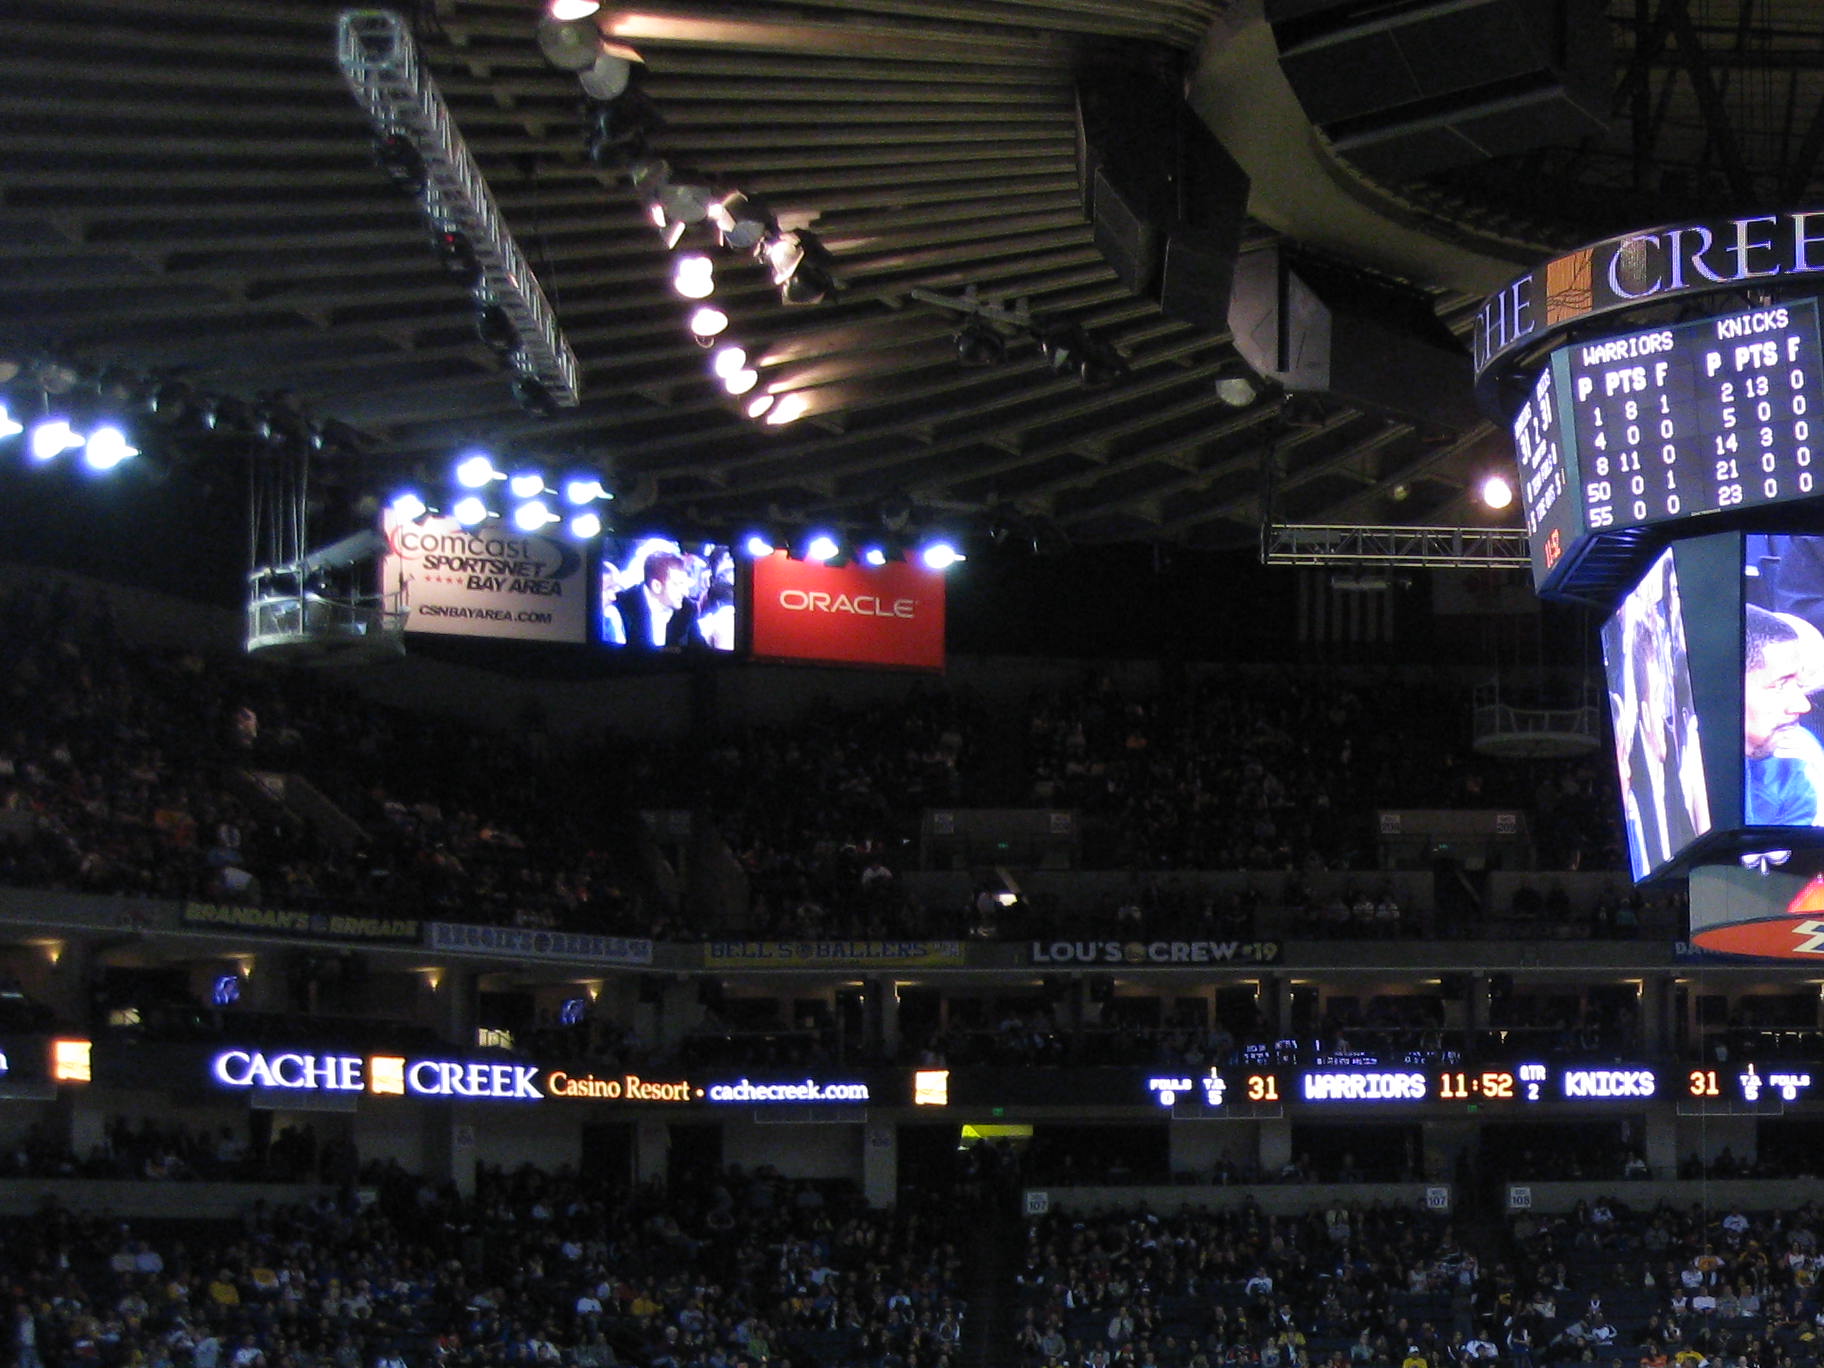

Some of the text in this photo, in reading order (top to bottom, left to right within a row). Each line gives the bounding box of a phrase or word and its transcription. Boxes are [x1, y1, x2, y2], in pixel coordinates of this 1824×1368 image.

[1583, 309, 1789, 367] WARRIORS KNICKS
[1578, 336, 1800, 401] P PTS F P PTS F
[1593, 369, 1804, 426] 1 8 1 2 13 0
[1594, 395, 1806, 450] 4 0 0 5 0 0
[1596, 421, 1808, 476] 8 11 0 14 3 0
[1587, 447, 1810, 502] 50 0 1 21 0 0
[1589, 506, 1613, 527] 55
[1633, 501, 1646, 520] 0
[1667, 495, 1680, 514] 0
[1718, 485, 1742, 506] 23
[1764, 479, 1777, 498] 0
[1799, 472, 1812, 491] 0
[400, 530, 531, 560] comcast
[422, 554, 546, 578] SPORTSNET
[466, 574, 562, 597] BAY AREA
[418, 604, 552, 625] CSNBAYAREA.COM
[779, 590, 916, 618] ORACLE
[1033, 940, 1123, 962] LOU'S
[1149, 940, 1240, 962] CREW
[216, 1051, 869, 1102] CACHE CREEK Casino Resort cachecreek.com
[1304, 1073, 1514, 1099] WARRIORS 11:52
[1520, 1065, 1546, 1081] QTR
[1565, 1071, 1720, 1097] KNICKS 31
[1248, 1075, 1279, 1101] 31
[1528, 1083, 1540, 1100] 2
